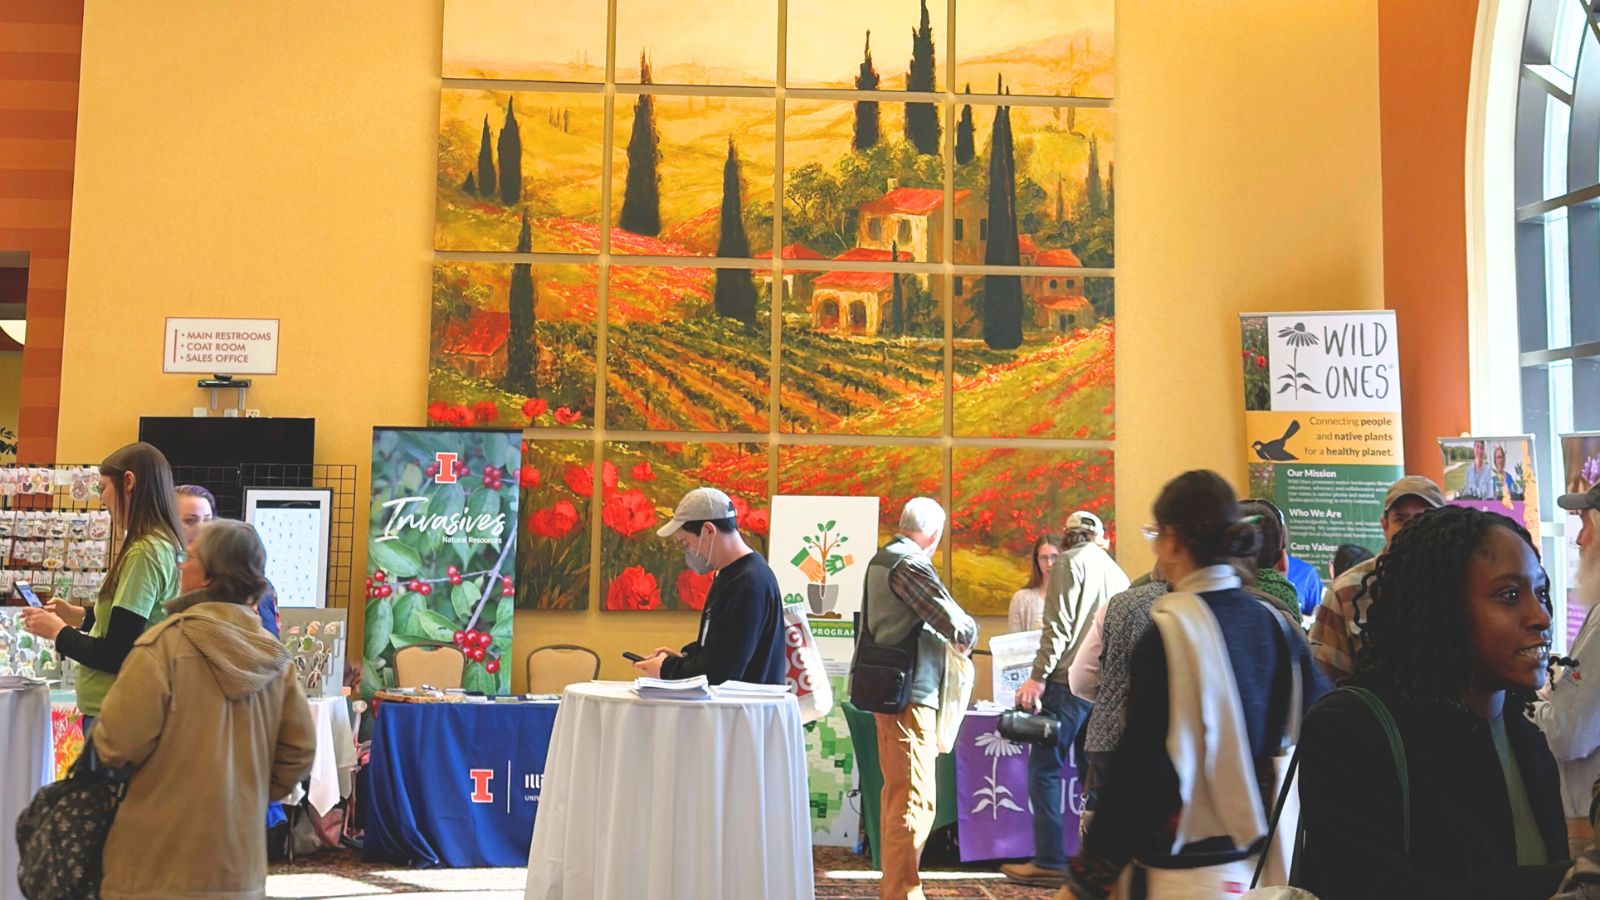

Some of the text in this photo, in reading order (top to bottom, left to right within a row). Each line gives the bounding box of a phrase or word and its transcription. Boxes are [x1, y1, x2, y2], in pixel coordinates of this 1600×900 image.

[186, 331, 272, 341] MAIN RESTROOMS
[1323, 322, 1388, 358] WILD
[186, 342, 246, 352] COAT ROOM
[185, 354, 249, 364] SALES OFFICE
[1325, 364, 1389, 400] ONES
[1309, 416, 1392, 427] Connecting people
[1316, 432, 1393, 442] and native plants
[1304, 447, 1317, 455] for
[1326, 447, 1360, 458] healthy
[1361, 448, 1394, 458] planet.
[1287, 469, 1337, 478] Our Mission
[1289, 508, 1342, 518] Who We Are
[374, 496, 506, 543] Invasives
[442, 536, 503, 544] Natural Resources
[1290, 542, 1311, 551] Core
